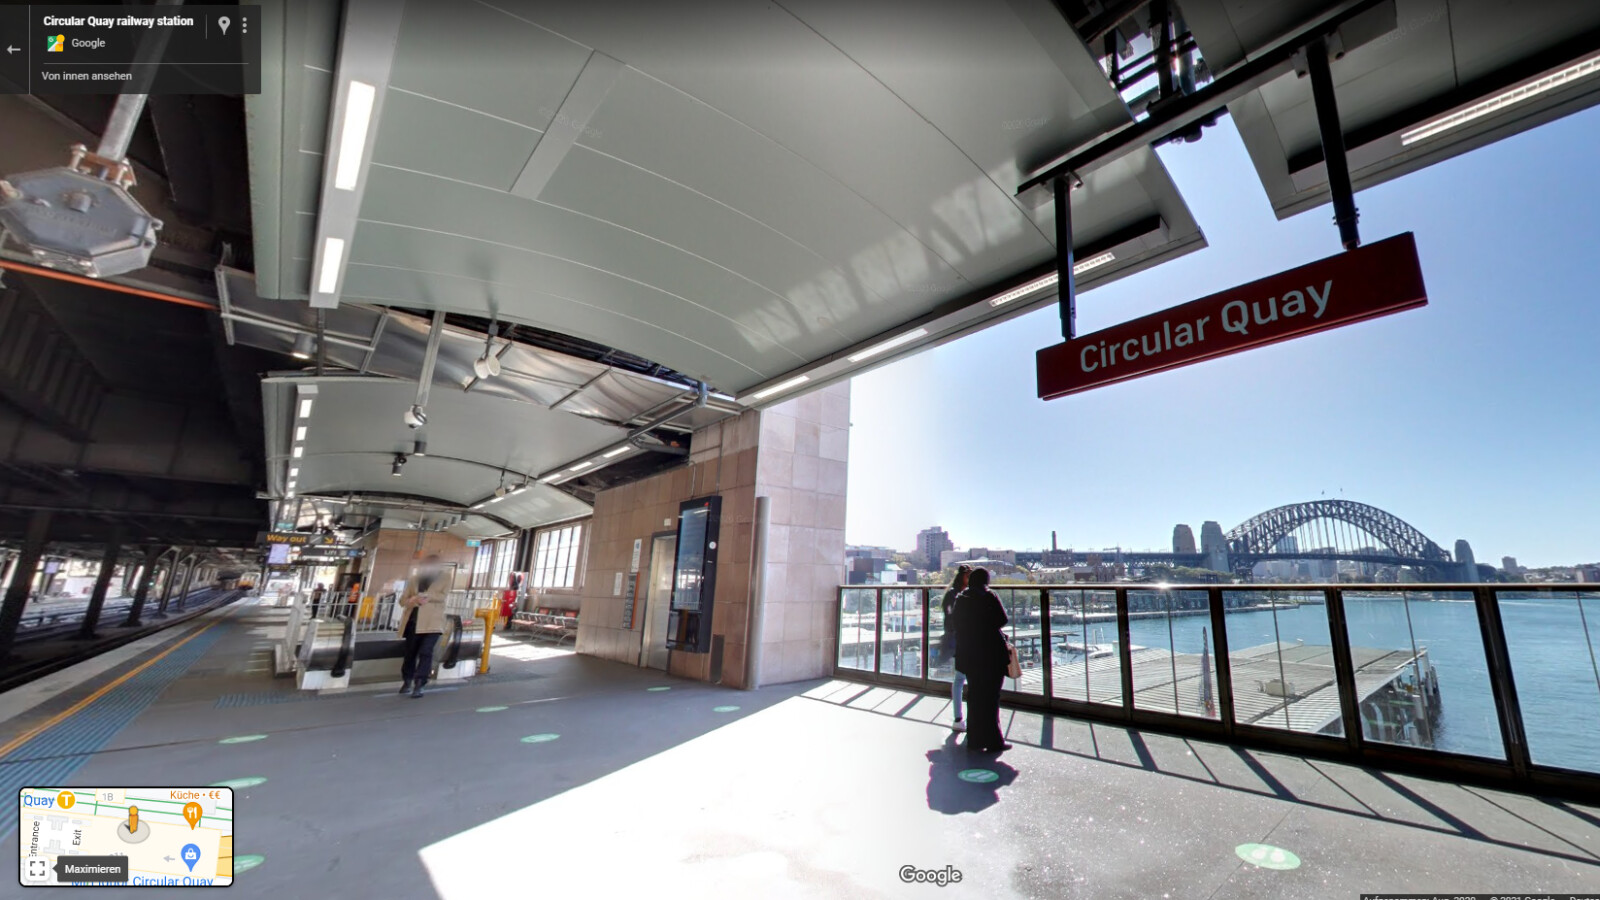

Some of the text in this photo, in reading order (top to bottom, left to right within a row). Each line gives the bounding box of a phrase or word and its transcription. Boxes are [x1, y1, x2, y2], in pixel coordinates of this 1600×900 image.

[1079, 279, 1333, 374] Circular Quay
[266, 534, 307, 543] Way out
